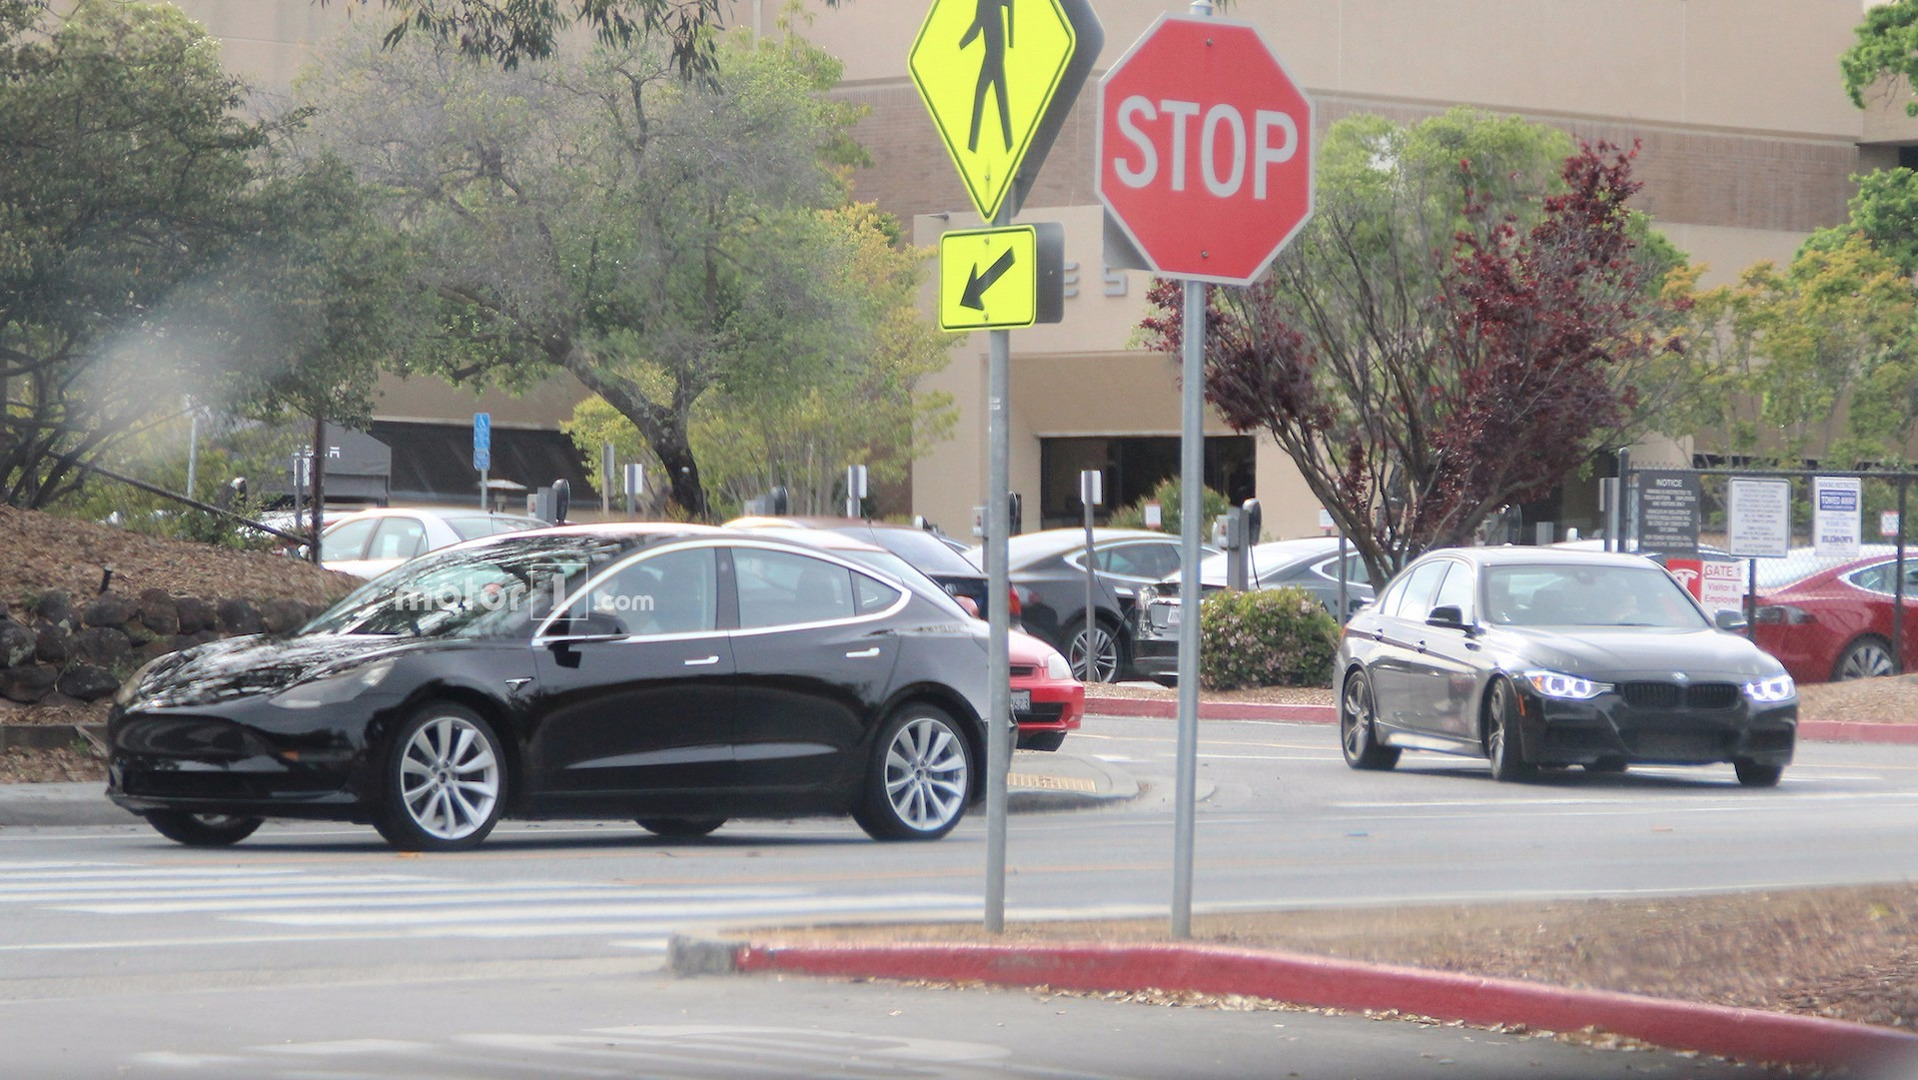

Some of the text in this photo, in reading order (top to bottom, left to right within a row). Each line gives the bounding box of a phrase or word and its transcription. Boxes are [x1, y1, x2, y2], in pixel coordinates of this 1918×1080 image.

[1114, 95, 1298, 200] STOP
[1656, 479, 1683, 487] NOTICE
[1705, 565, 1733, 576] GATE
[1708, 582, 1731, 592] Visitor
[1704, 594, 1740, 605] Employee
